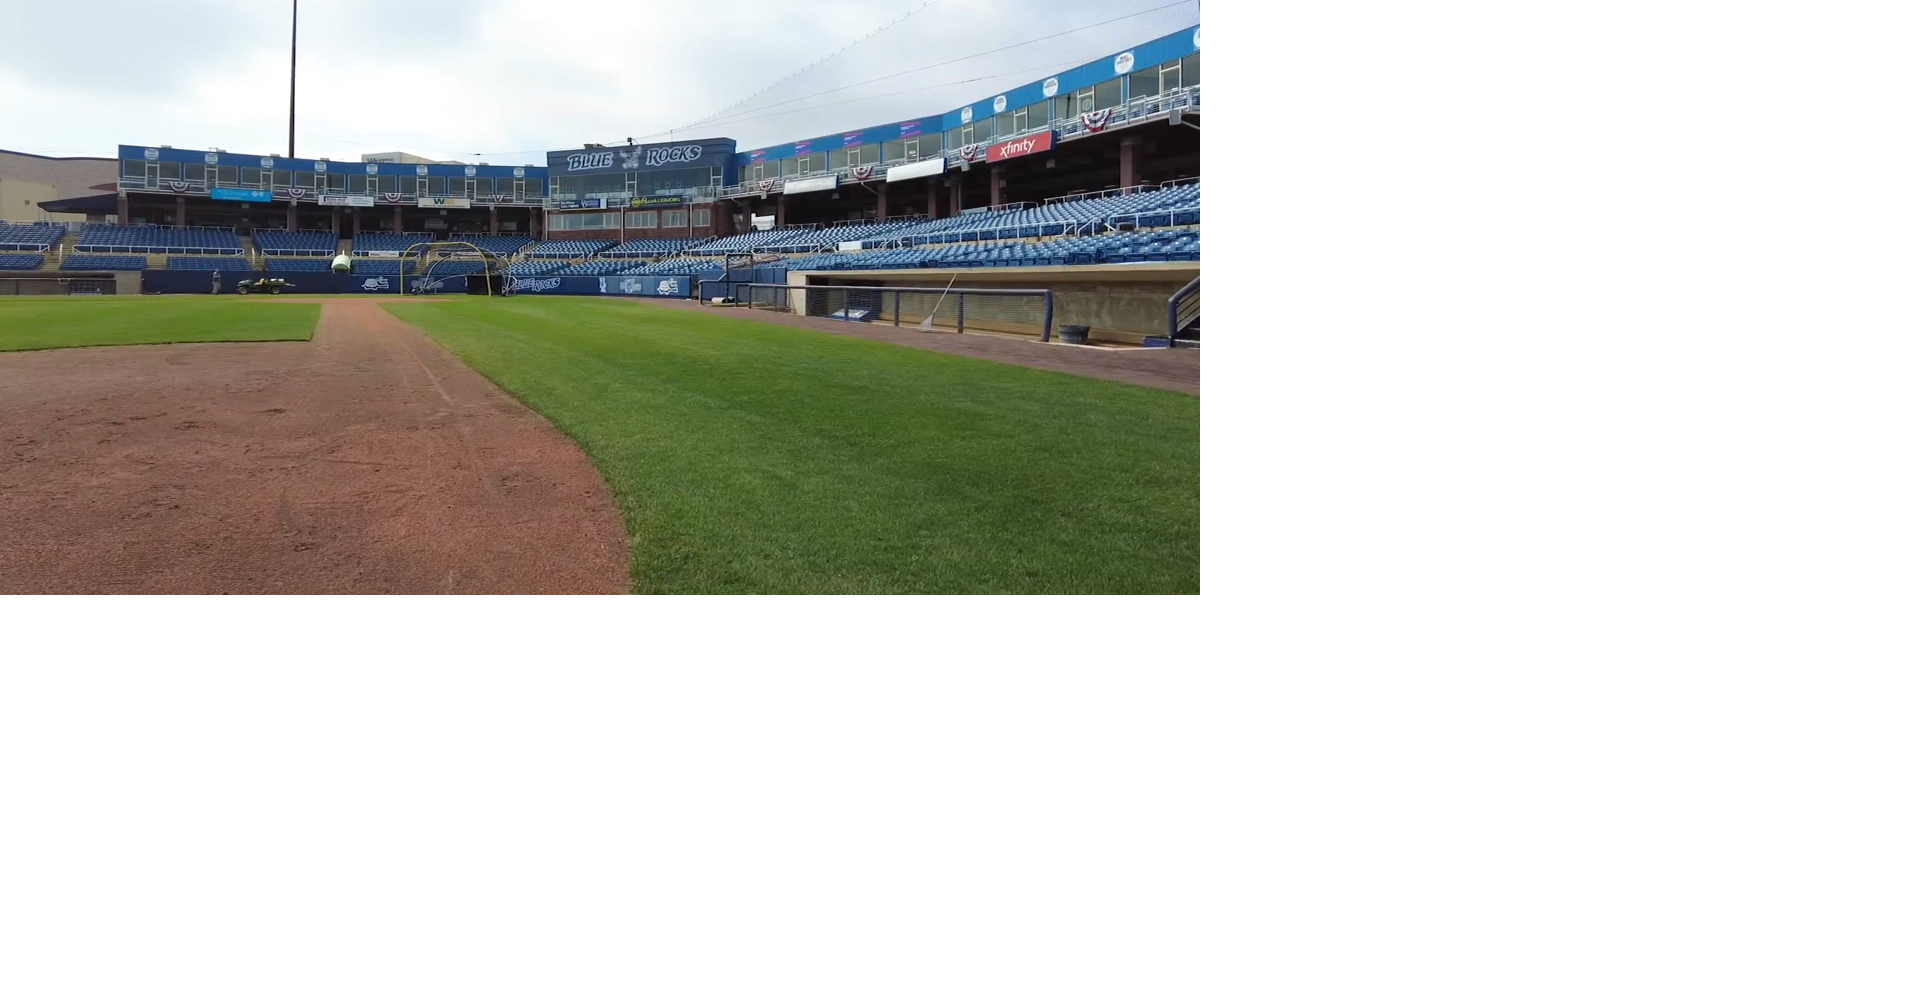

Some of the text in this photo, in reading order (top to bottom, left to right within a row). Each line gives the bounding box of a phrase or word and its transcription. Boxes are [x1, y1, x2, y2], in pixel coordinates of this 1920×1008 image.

[566, 144, 703, 172] BLUE ROCKS
[1000, 138, 1036, 158] xfinity
[532, 277, 561, 292] ROCKS
